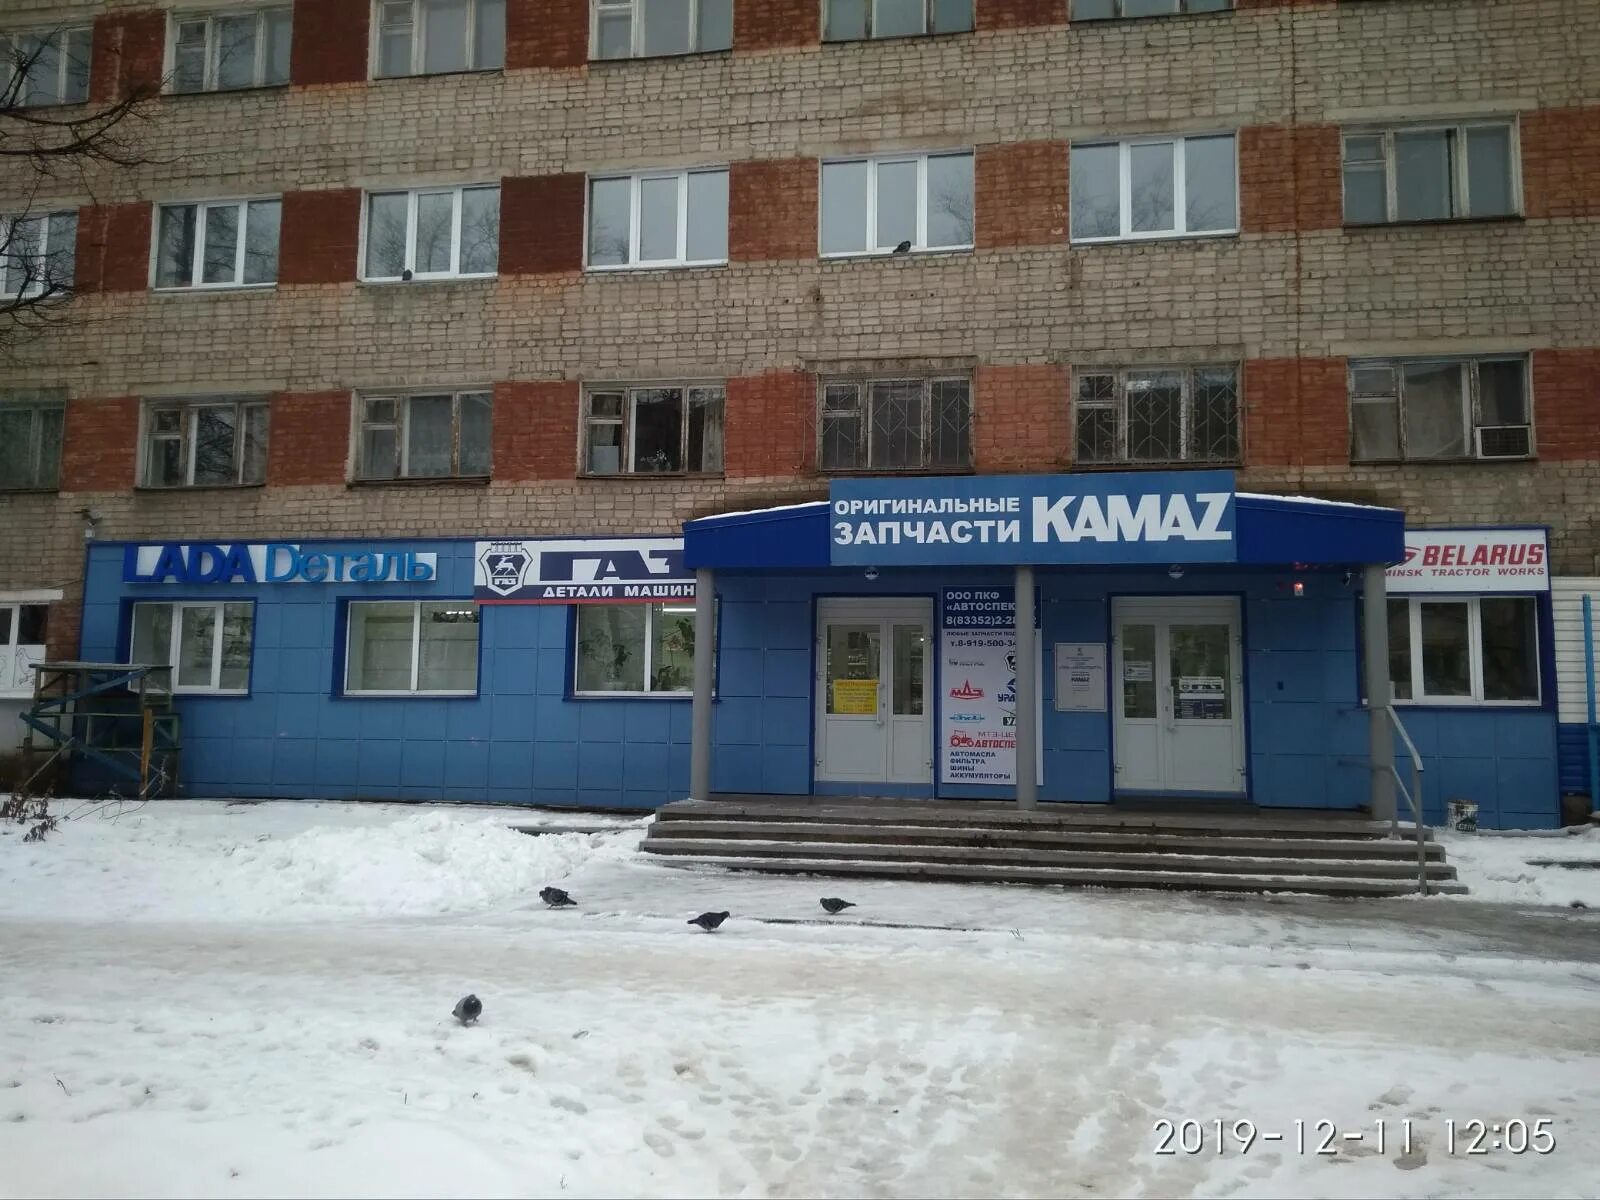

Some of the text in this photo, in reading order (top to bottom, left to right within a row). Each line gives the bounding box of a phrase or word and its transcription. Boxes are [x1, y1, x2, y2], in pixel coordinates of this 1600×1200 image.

[834, 497, 1020, 515] ОРИГИНАЛЬНЫЕ
[1032, 492, 1232, 543] KAMAZ
[834, 519, 1020, 545] ЗАПЧАСТИ
[1422, 543, 1545, 566] BELARUS
[122, 543, 257, 583] LADA
[1431, 568, 1490, 576] TRACTOR
[1498, 567, 1544, 576] WORKS
[543, 586, 613, 598] ДЕТАЛИ
[946, 591, 999, 600] ООО ПКФ
[946, 602, 1016, 611] «АВТОСПЕК
[997, 693, 1016, 702] УРА
[974, 739, 1016, 748] АВТОСПЕ
